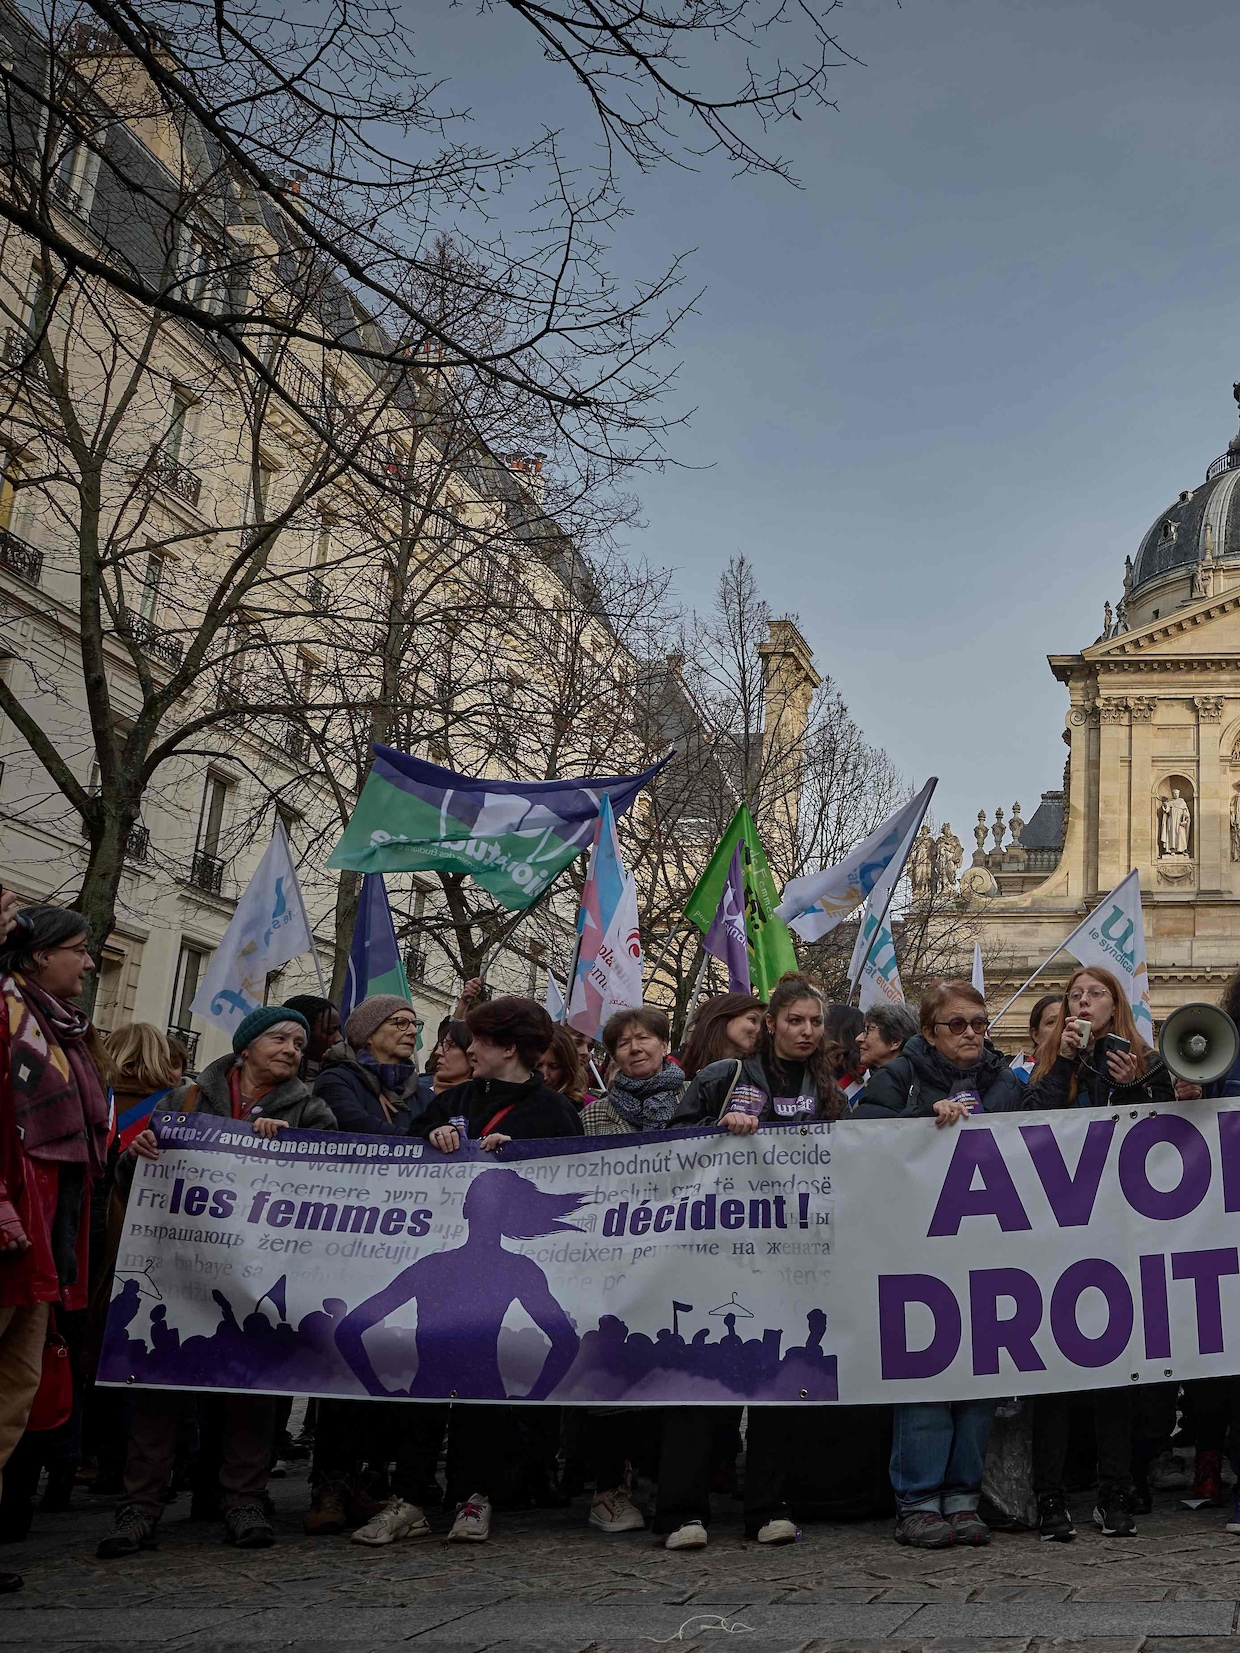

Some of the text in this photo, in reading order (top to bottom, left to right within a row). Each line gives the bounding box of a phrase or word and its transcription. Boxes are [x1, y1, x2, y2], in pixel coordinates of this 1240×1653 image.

[1088, 927, 1099, 941] le
[160, 1125, 424, 1159] http://avortementeurope.org
[676, 1143, 831, 1171] Women decide
[143, 1159, 371, 1203] mulieres decernere
[748, 1173, 832, 1197] vendosë
[169, 1178, 238, 1219] les
[246, 1190, 434, 1238] femmes
[602, 1193, 788, 1237] décident
[257, 1233, 314, 1256] žene
[878, 1247, 1239, 1380] DROIT
